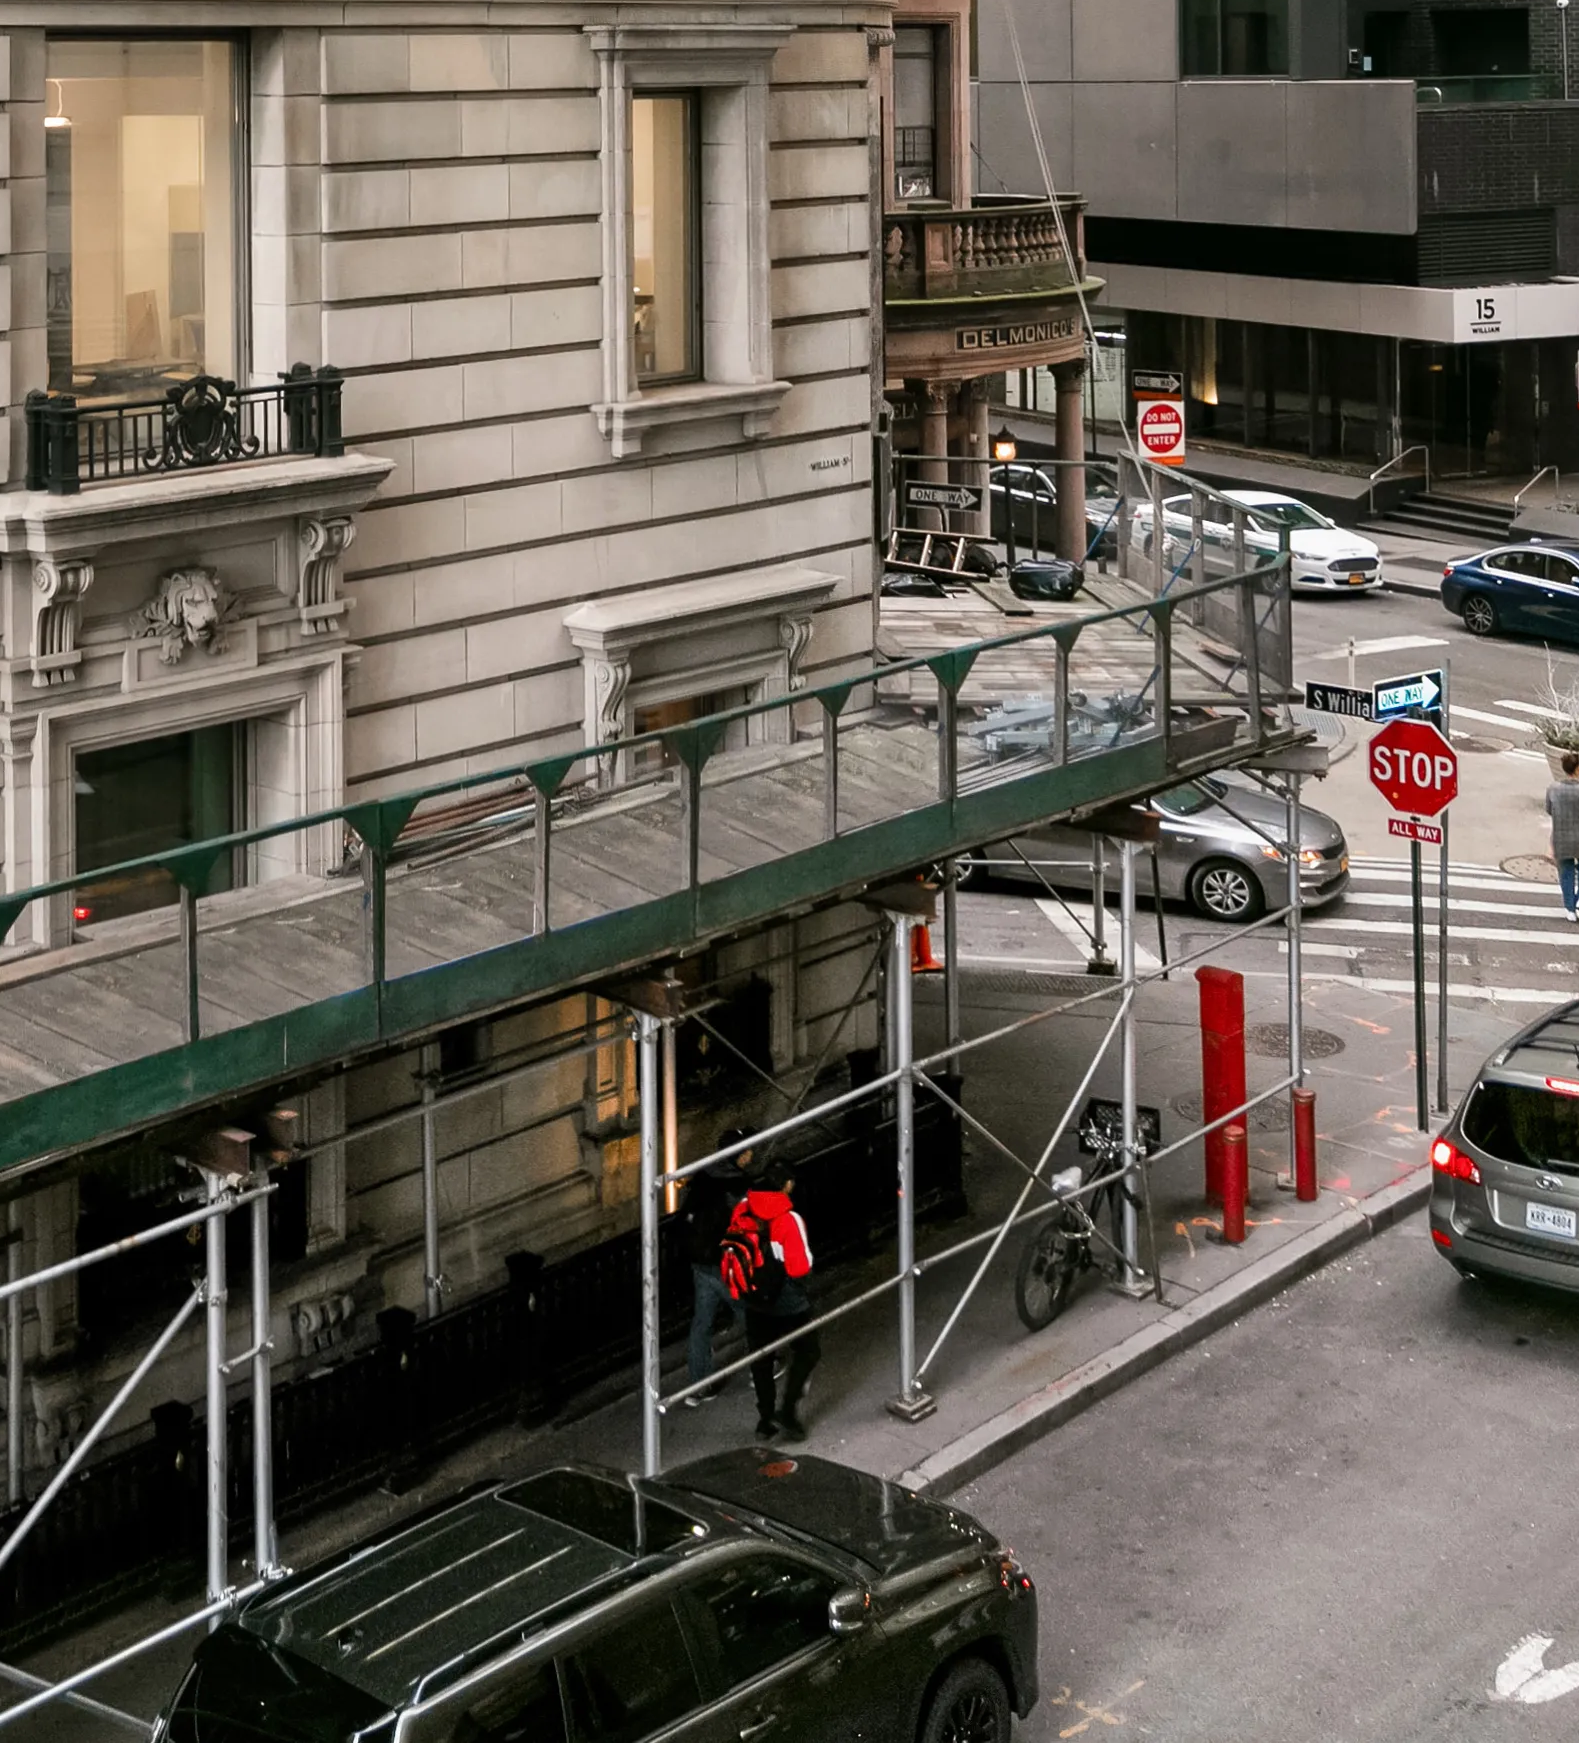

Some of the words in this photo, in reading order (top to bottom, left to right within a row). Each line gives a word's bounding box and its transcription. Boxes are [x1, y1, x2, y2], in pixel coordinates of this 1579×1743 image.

[1476, 298, 1495, 320] 15
[962, 318, 1076, 349] DELMONICO'S
[1472, 326, 1500, 334] WILLIAM
[1146, 413, 1158, 422] DO
[1160, 412, 1176, 421] NOT
[1147, 435, 1175, 445] ENTER
[915, 489, 937, 501] ONE
[948, 492, 971, 503] WAY
[1313, 690, 1323, 709] S
[1327, 691, 1372, 718] Willia
[1380, 692, 1399, 708] ONE
[1404, 686, 1424, 703] WAY
[1372, 745, 1454, 791] STOP
[1391, 822, 1412, 836] ALL
[1416, 826, 1438, 840] WAY
